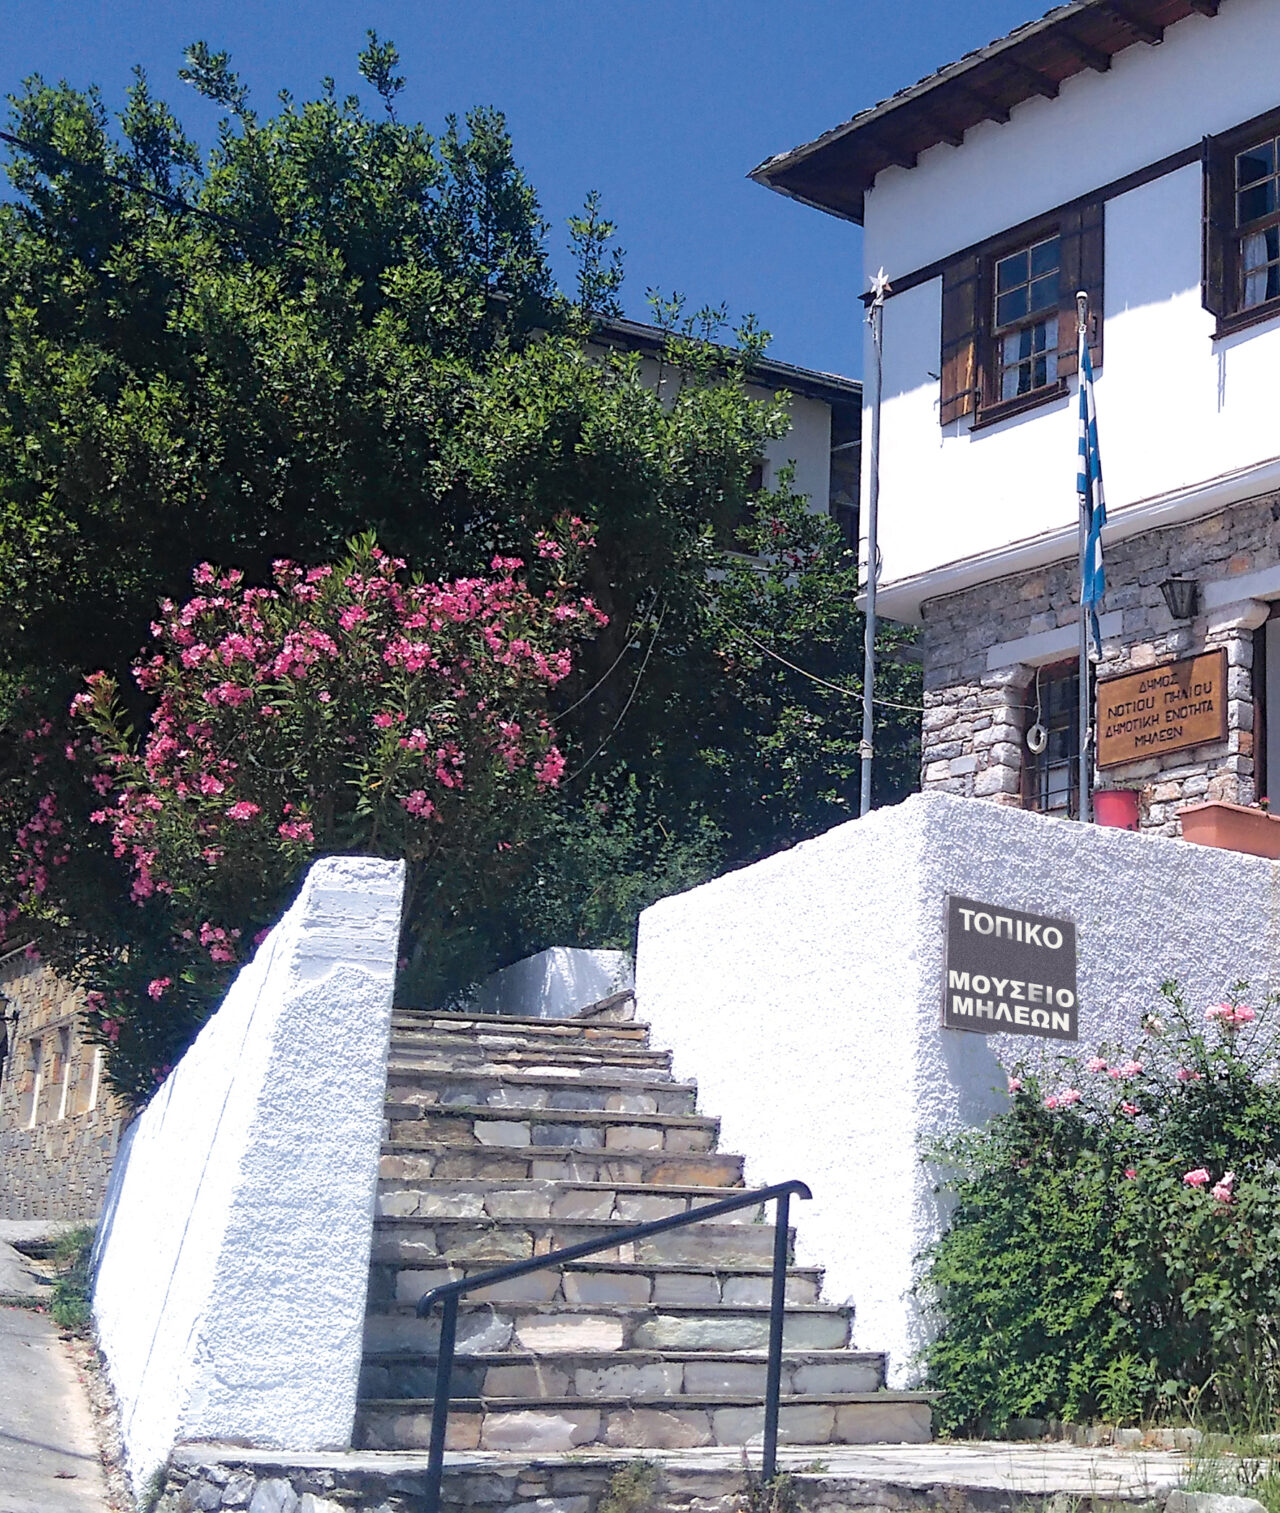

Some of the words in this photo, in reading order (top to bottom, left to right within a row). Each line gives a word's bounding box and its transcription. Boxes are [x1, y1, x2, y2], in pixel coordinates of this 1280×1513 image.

[1139, 673, 1179, 693] ΔΗΜΟΣ
[1105, 713, 1160, 738] ΔΗΜΟΤΙΚΗ
[1165, 700, 1214, 723] ΕΝΟΤΗΤΑ
[1135, 726, 1183, 748] ΜΗΛΕΩΝ
[958, 907, 1063, 950] ΤΟΠΙΚΟ
[949, 969, 1075, 1008] ΜΟΥΣΕΙΟ
[952, 995, 1070, 1032] ΜΗΛΕΩΝ
